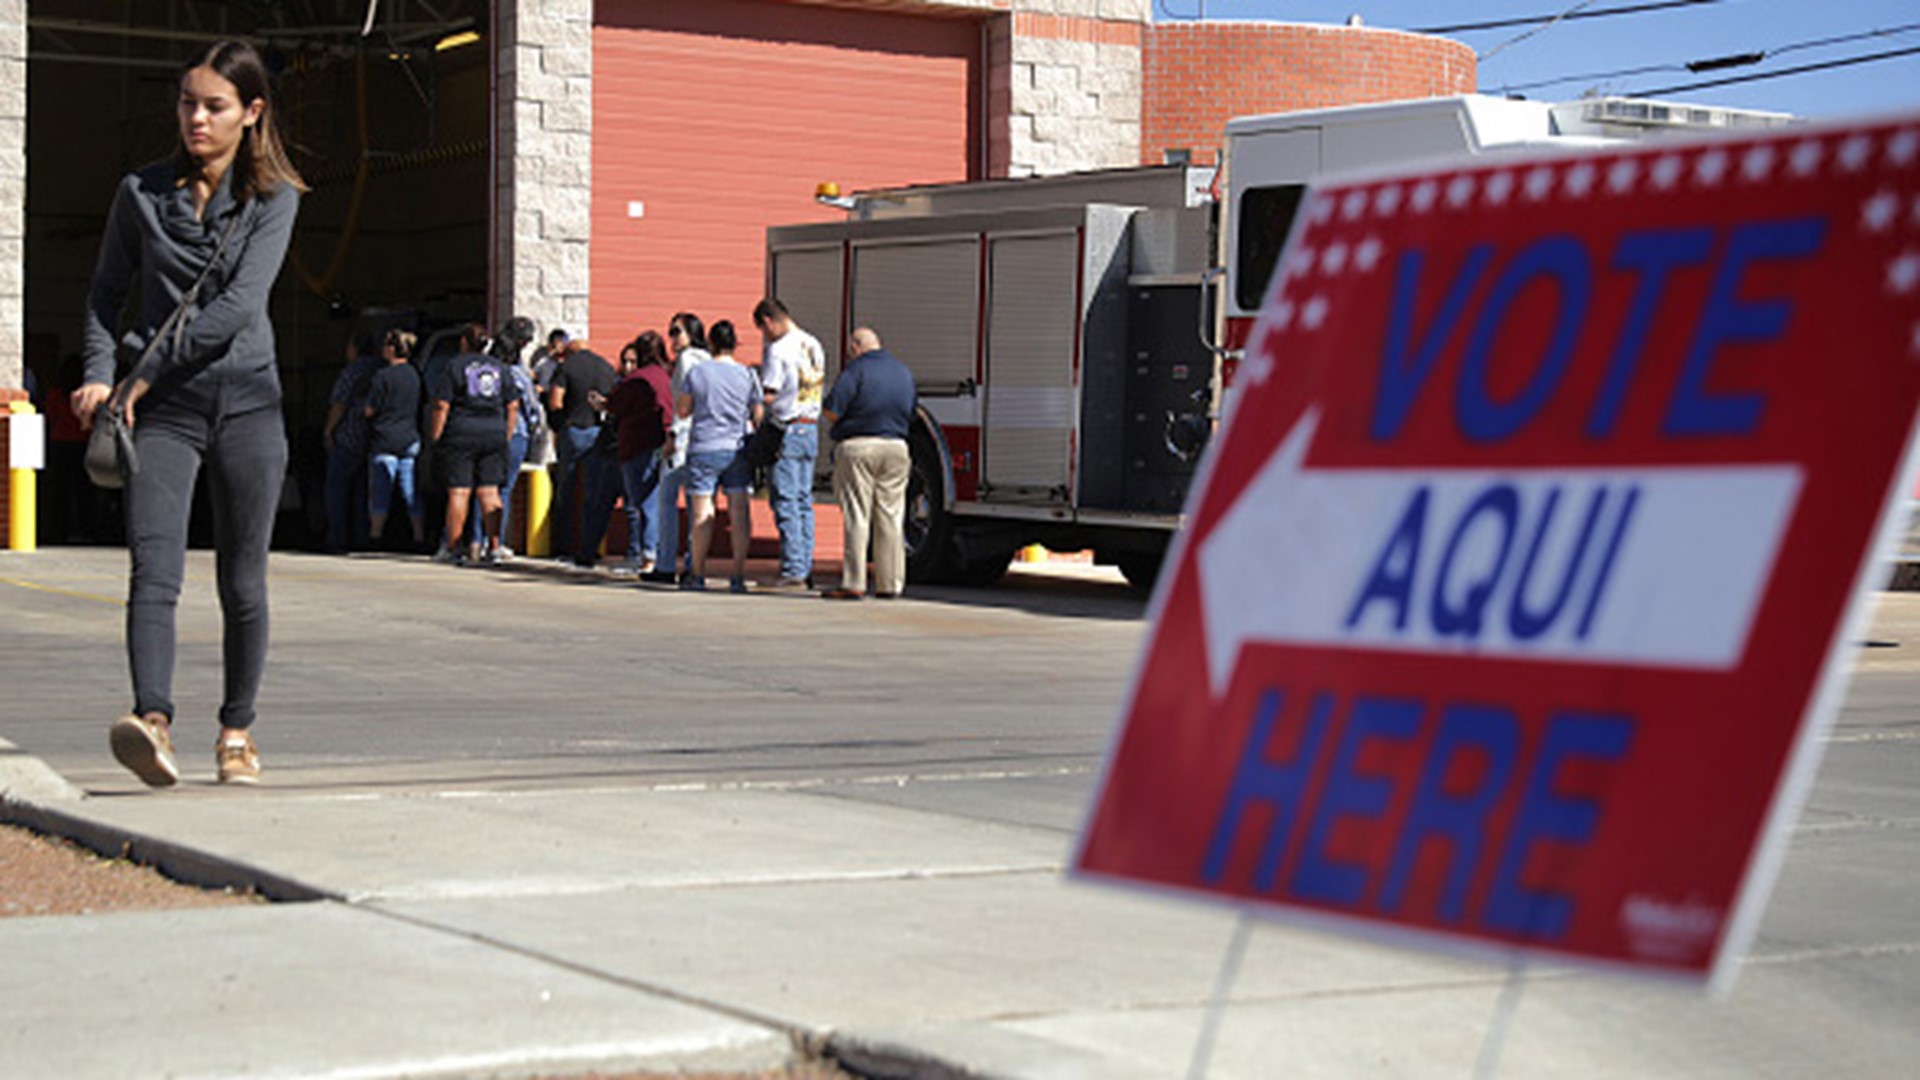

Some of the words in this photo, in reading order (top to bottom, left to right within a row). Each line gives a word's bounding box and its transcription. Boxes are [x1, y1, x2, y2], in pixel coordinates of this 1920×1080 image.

[1370, 218, 1828, 442] VOTE
[1345, 484, 1641, 641] AQUI
[1203, 688, 1635, 938] HERE
